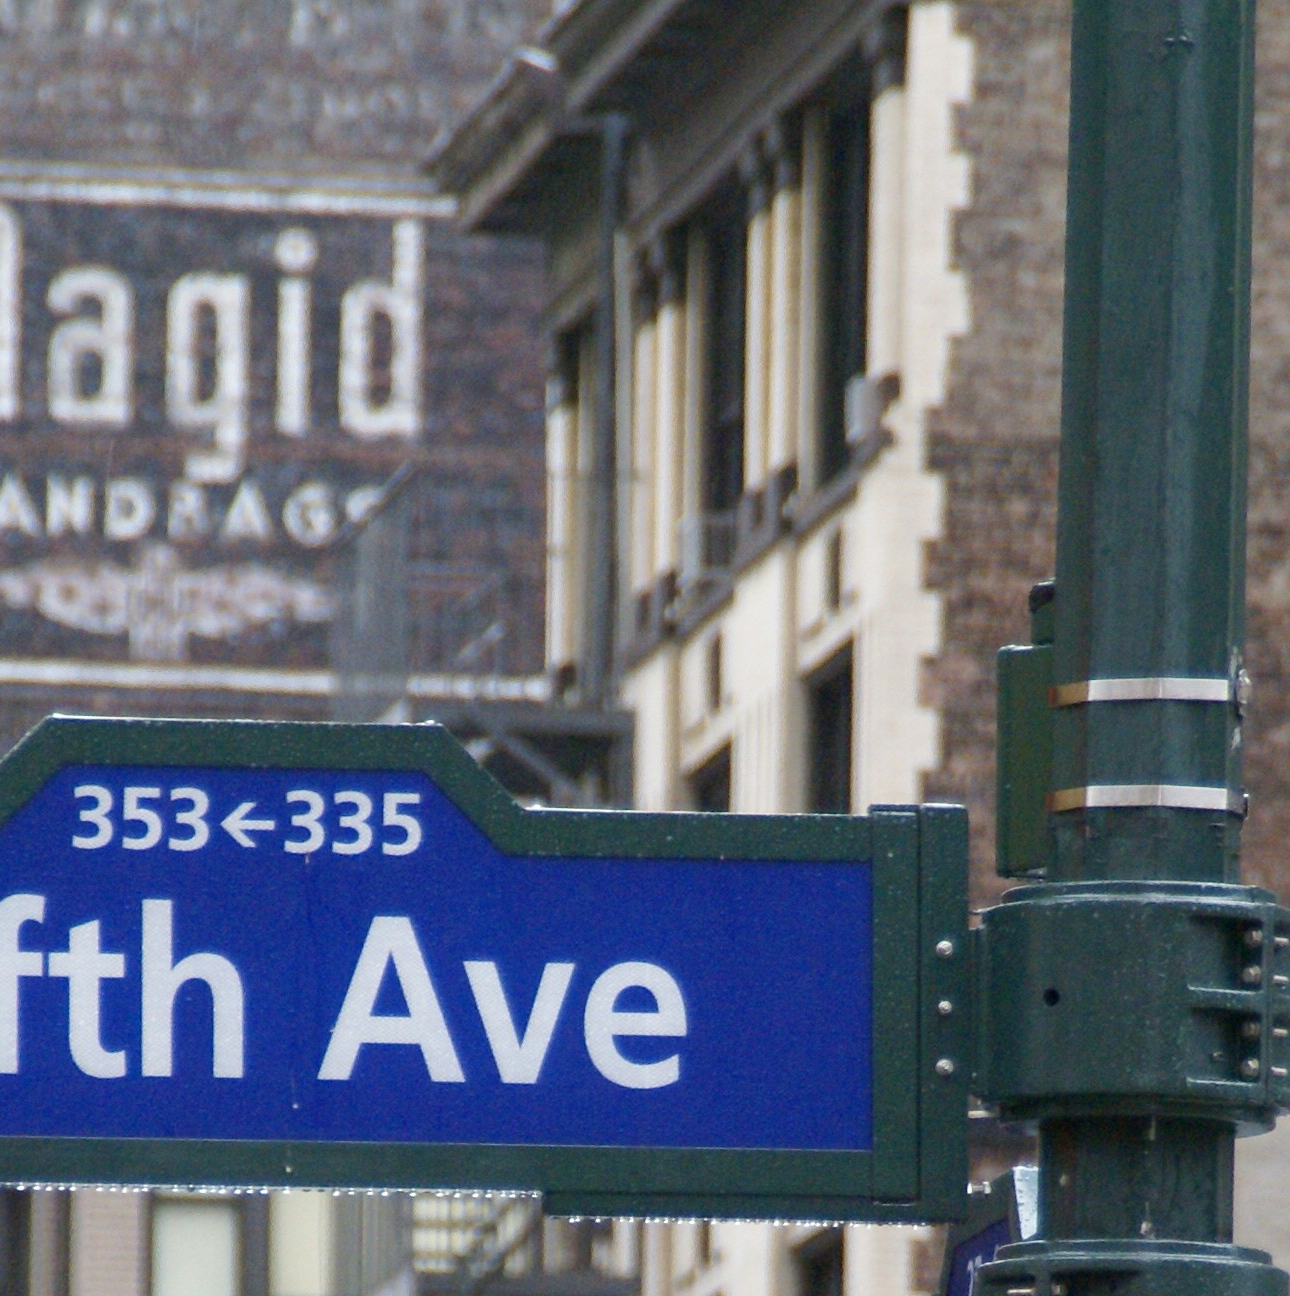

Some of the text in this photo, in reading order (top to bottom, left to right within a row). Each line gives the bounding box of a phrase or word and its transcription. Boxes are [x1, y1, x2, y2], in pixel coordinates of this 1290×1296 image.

[71, 784, 423, 856] 353 335
[317, 915, 689, 1090] Ave
